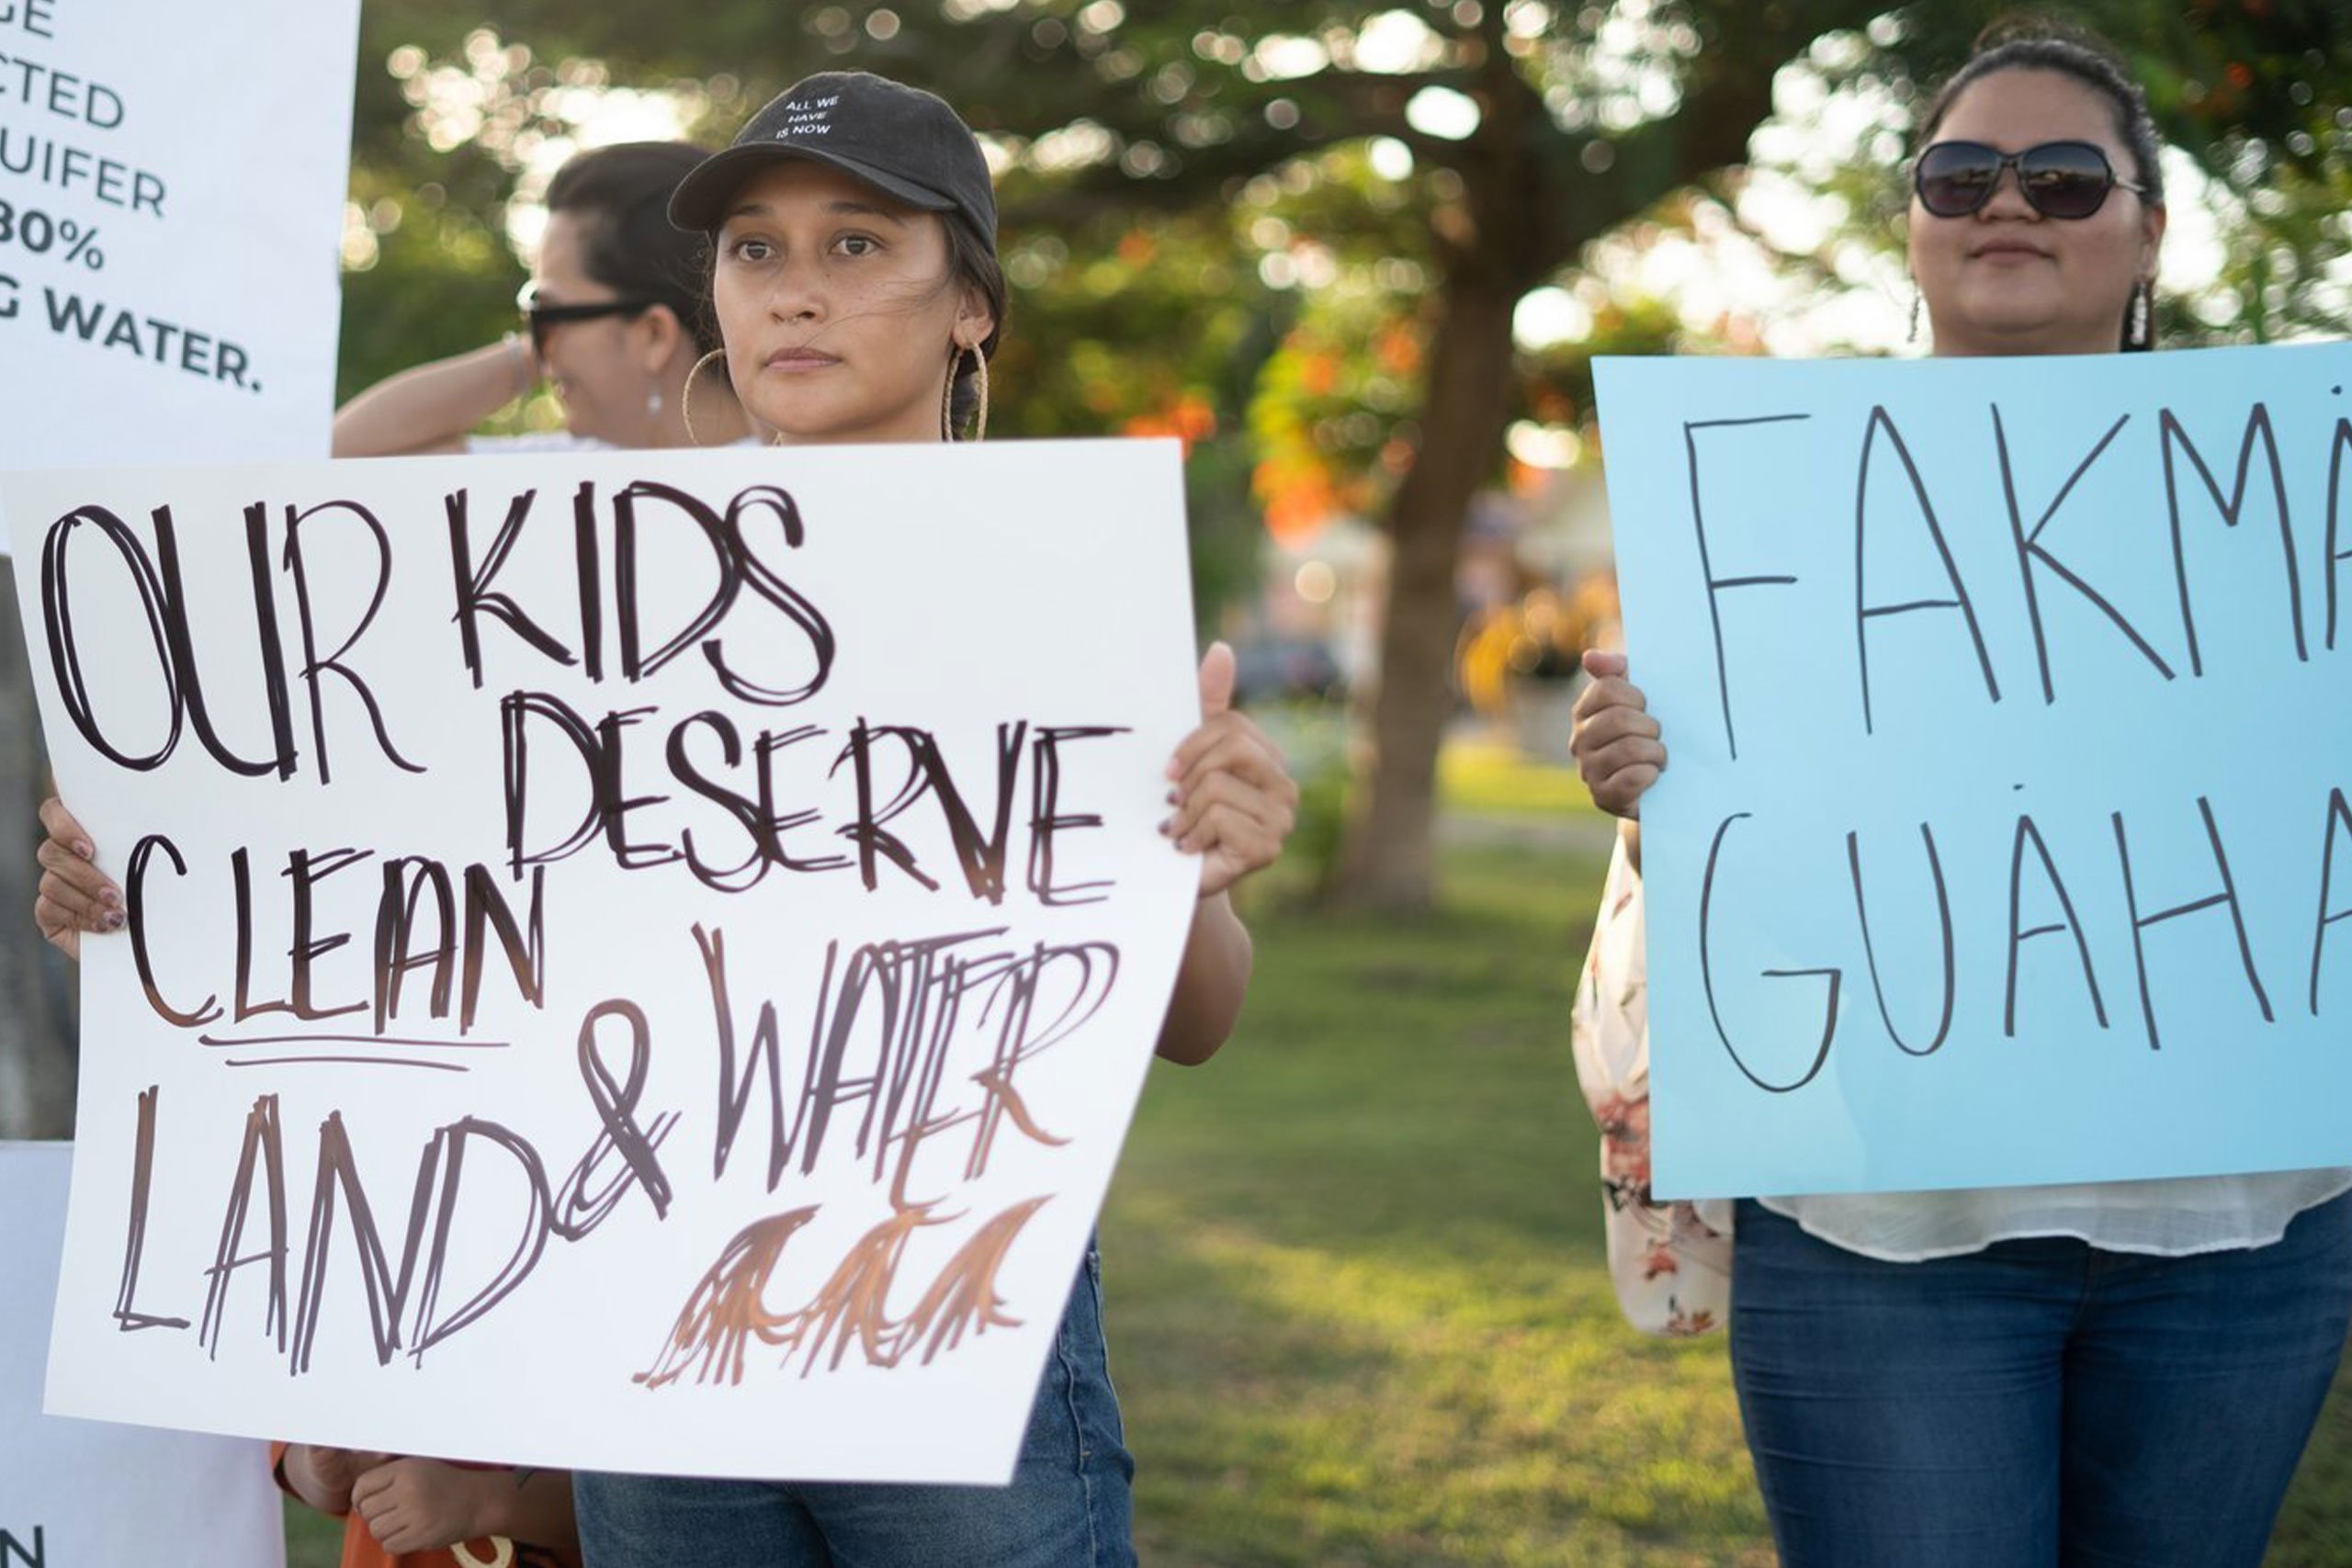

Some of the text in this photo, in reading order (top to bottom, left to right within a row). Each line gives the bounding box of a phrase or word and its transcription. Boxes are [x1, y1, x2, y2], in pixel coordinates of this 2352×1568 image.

[0, 53, 125, 130] TED
[775, 124, 831, 140] IS NOW
[786, 95, 840, 111] ALL WE
[787, 111, 827, 123] HAVE
[0, 128, 167, 218] UIFER
[44, 286, 262, 393] WATER.
[41, 480, 835, 785] OUR KIDS
[501, 690, 1134, 908] DESERVE
[125, 834, 546, 1036] CLEAN
[114, 921, 1120, 1377] LAND & WATER
